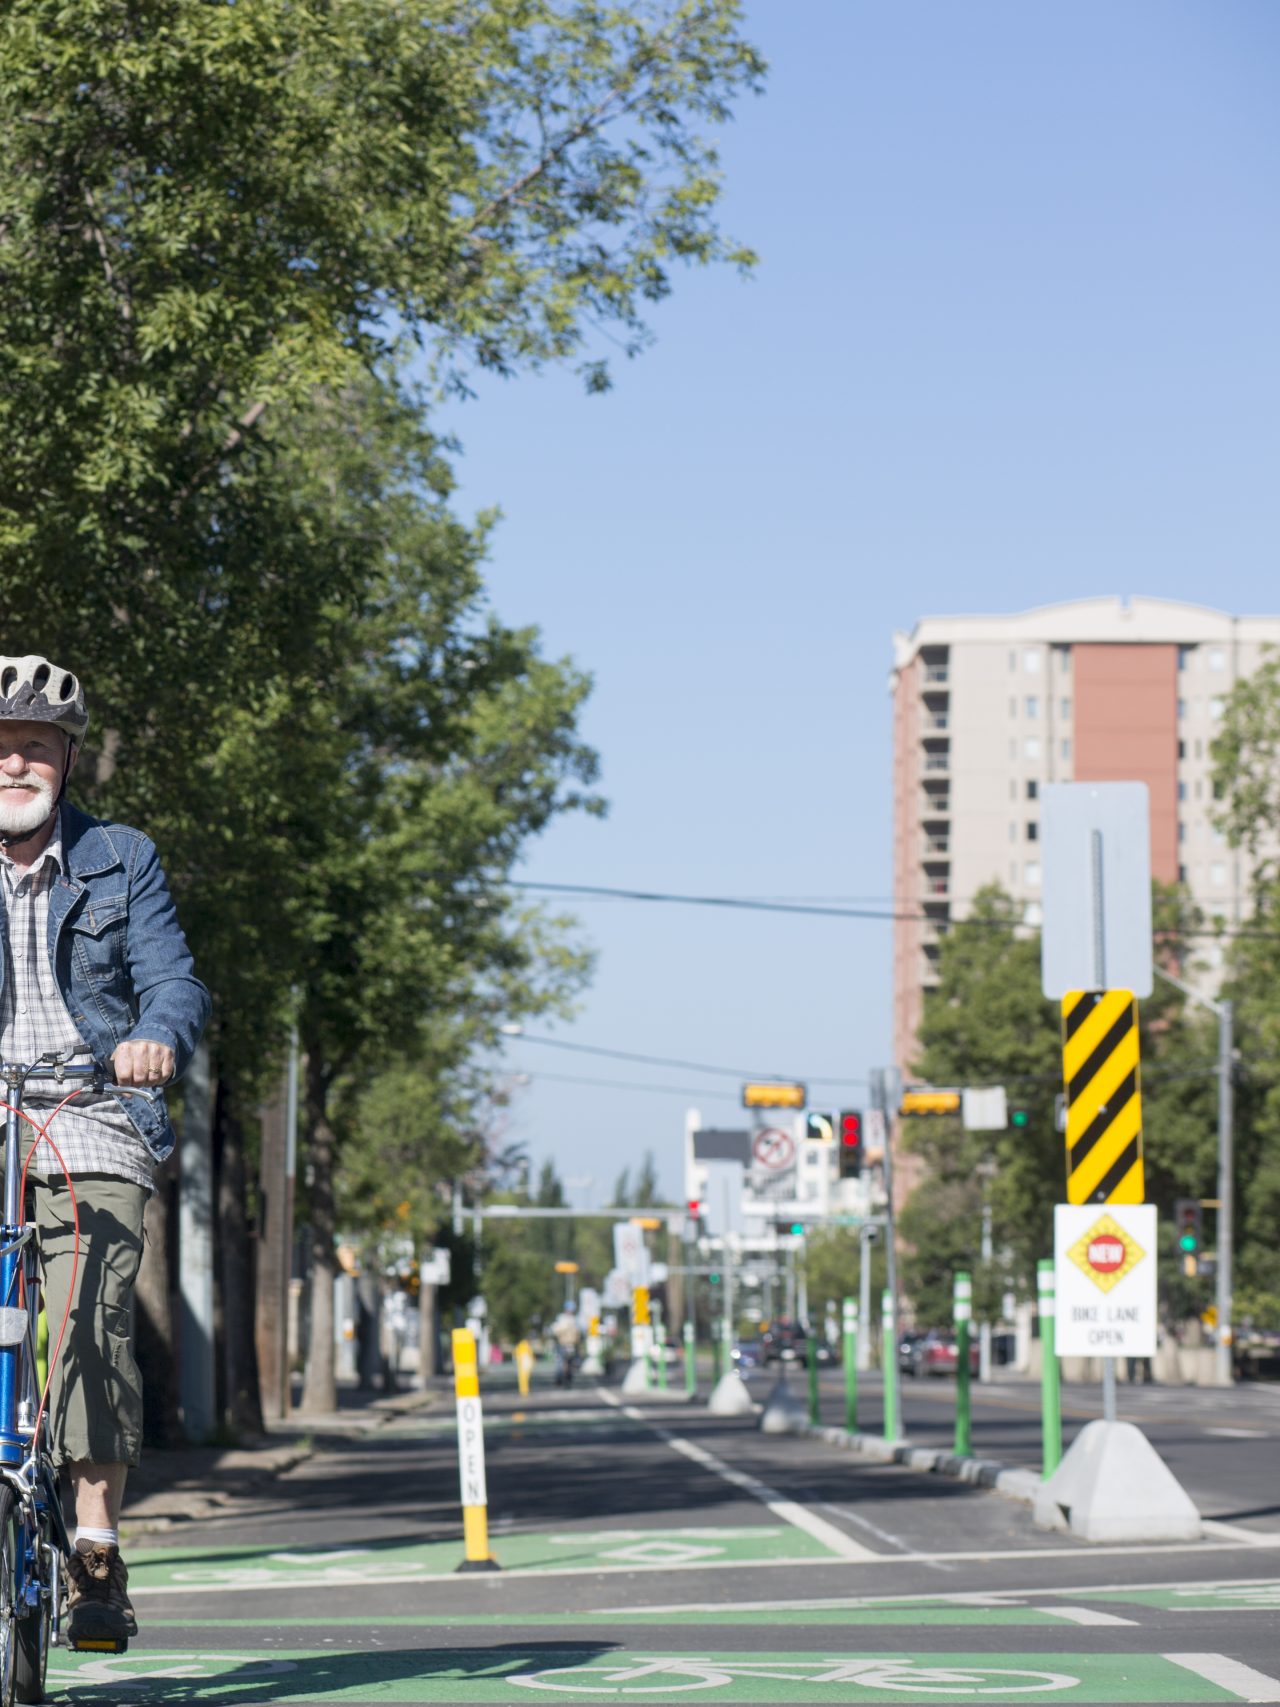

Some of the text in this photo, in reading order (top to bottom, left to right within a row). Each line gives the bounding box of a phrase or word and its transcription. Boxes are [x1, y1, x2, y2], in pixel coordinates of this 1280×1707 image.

[1087, 1243, 1124, 1264] NEW
[1072, 1306, 1139, 1322] BIKE LANE
[1088, 1329, 1124, 1345] OPEN
[464, 1404, 479, 1498] OPEN
